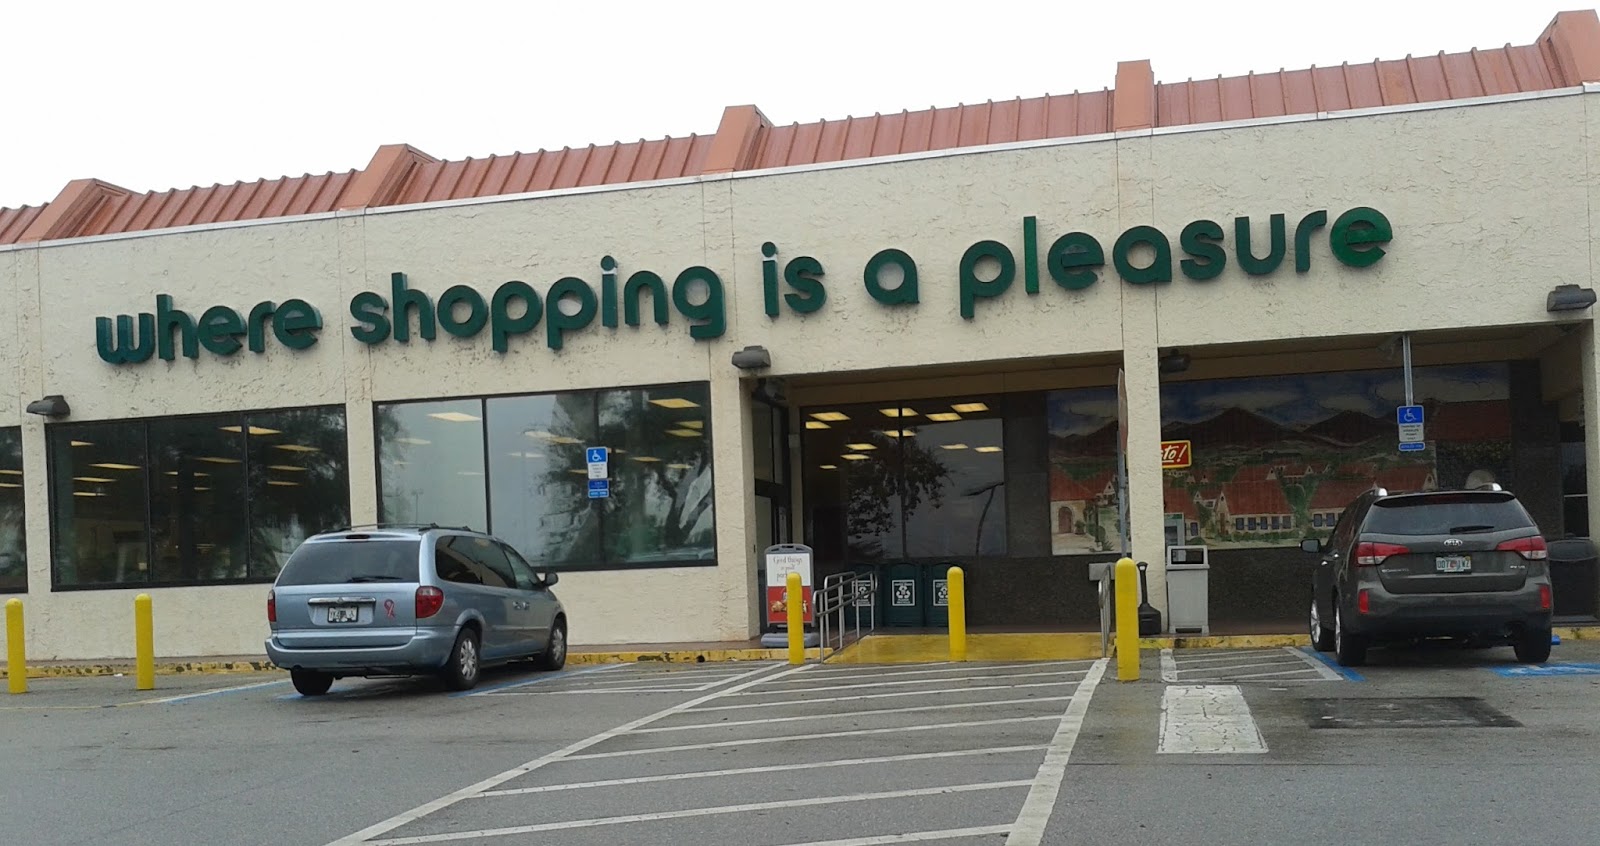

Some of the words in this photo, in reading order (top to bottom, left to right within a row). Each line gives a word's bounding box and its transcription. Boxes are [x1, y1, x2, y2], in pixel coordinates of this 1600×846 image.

[96, 293, 322, 365] where
[351, 255, 726, 354] shopping
[763, 241, 826, 317] is
[864, 248, 919, 305] a
[959, 206, 1393, 319] pleasure
